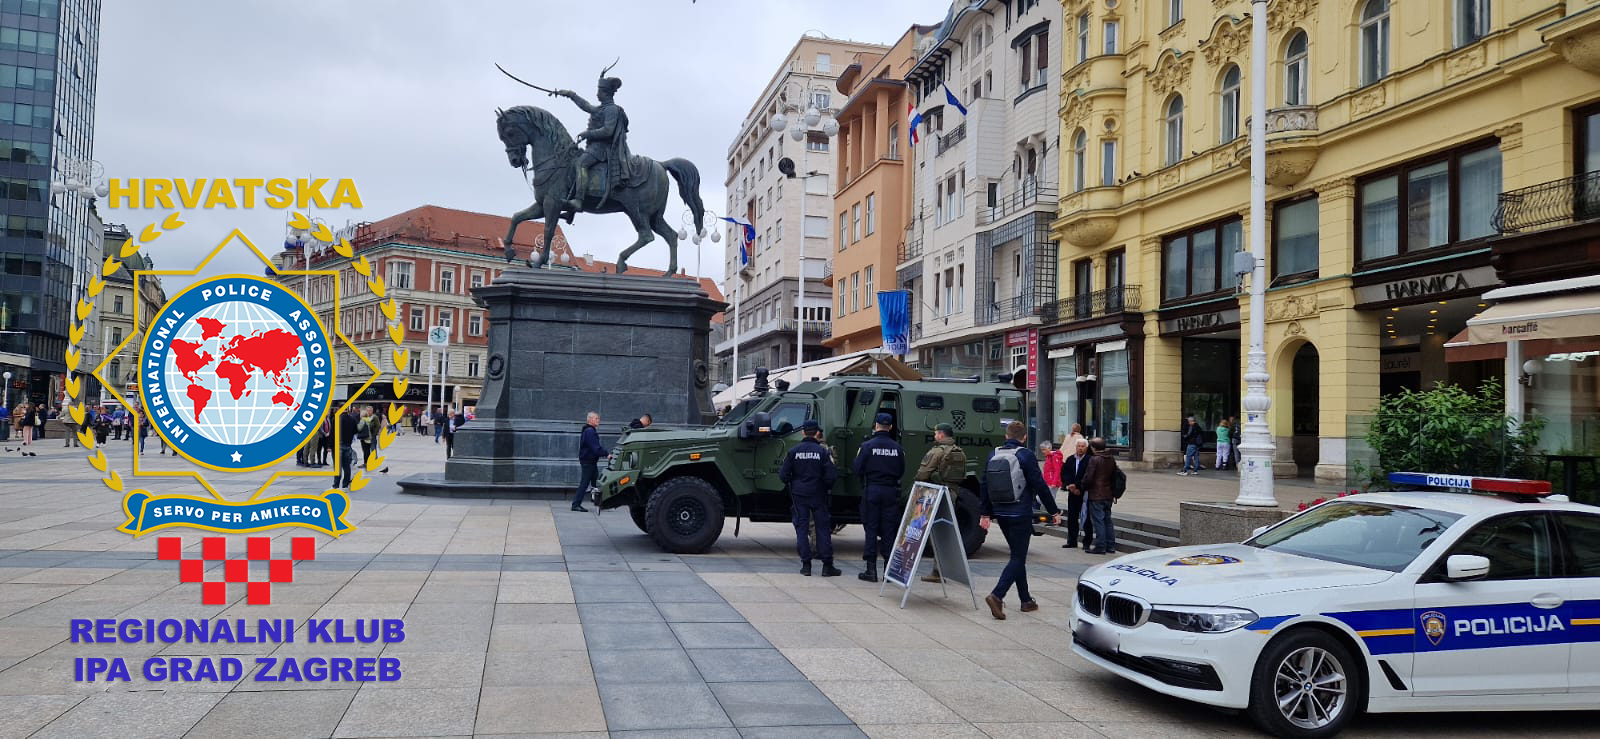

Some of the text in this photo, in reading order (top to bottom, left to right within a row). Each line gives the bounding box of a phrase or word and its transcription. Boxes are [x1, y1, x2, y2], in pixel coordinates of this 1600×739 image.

[1385, 272, 1469, 300] HARMICA
[1177, 313, 1225, 332] HARMICA
[925, 434, 993, 448] PICIJA
[794, 452, 821, 461] POLICIJA
[872, 448, 898, 457] POLICIJA
[1428, 476, 1471, 488] POLICIJA
[1107, 564, 1178, 586] POLICIJA
[1454, 614, 1565, 636] POLICIJA
